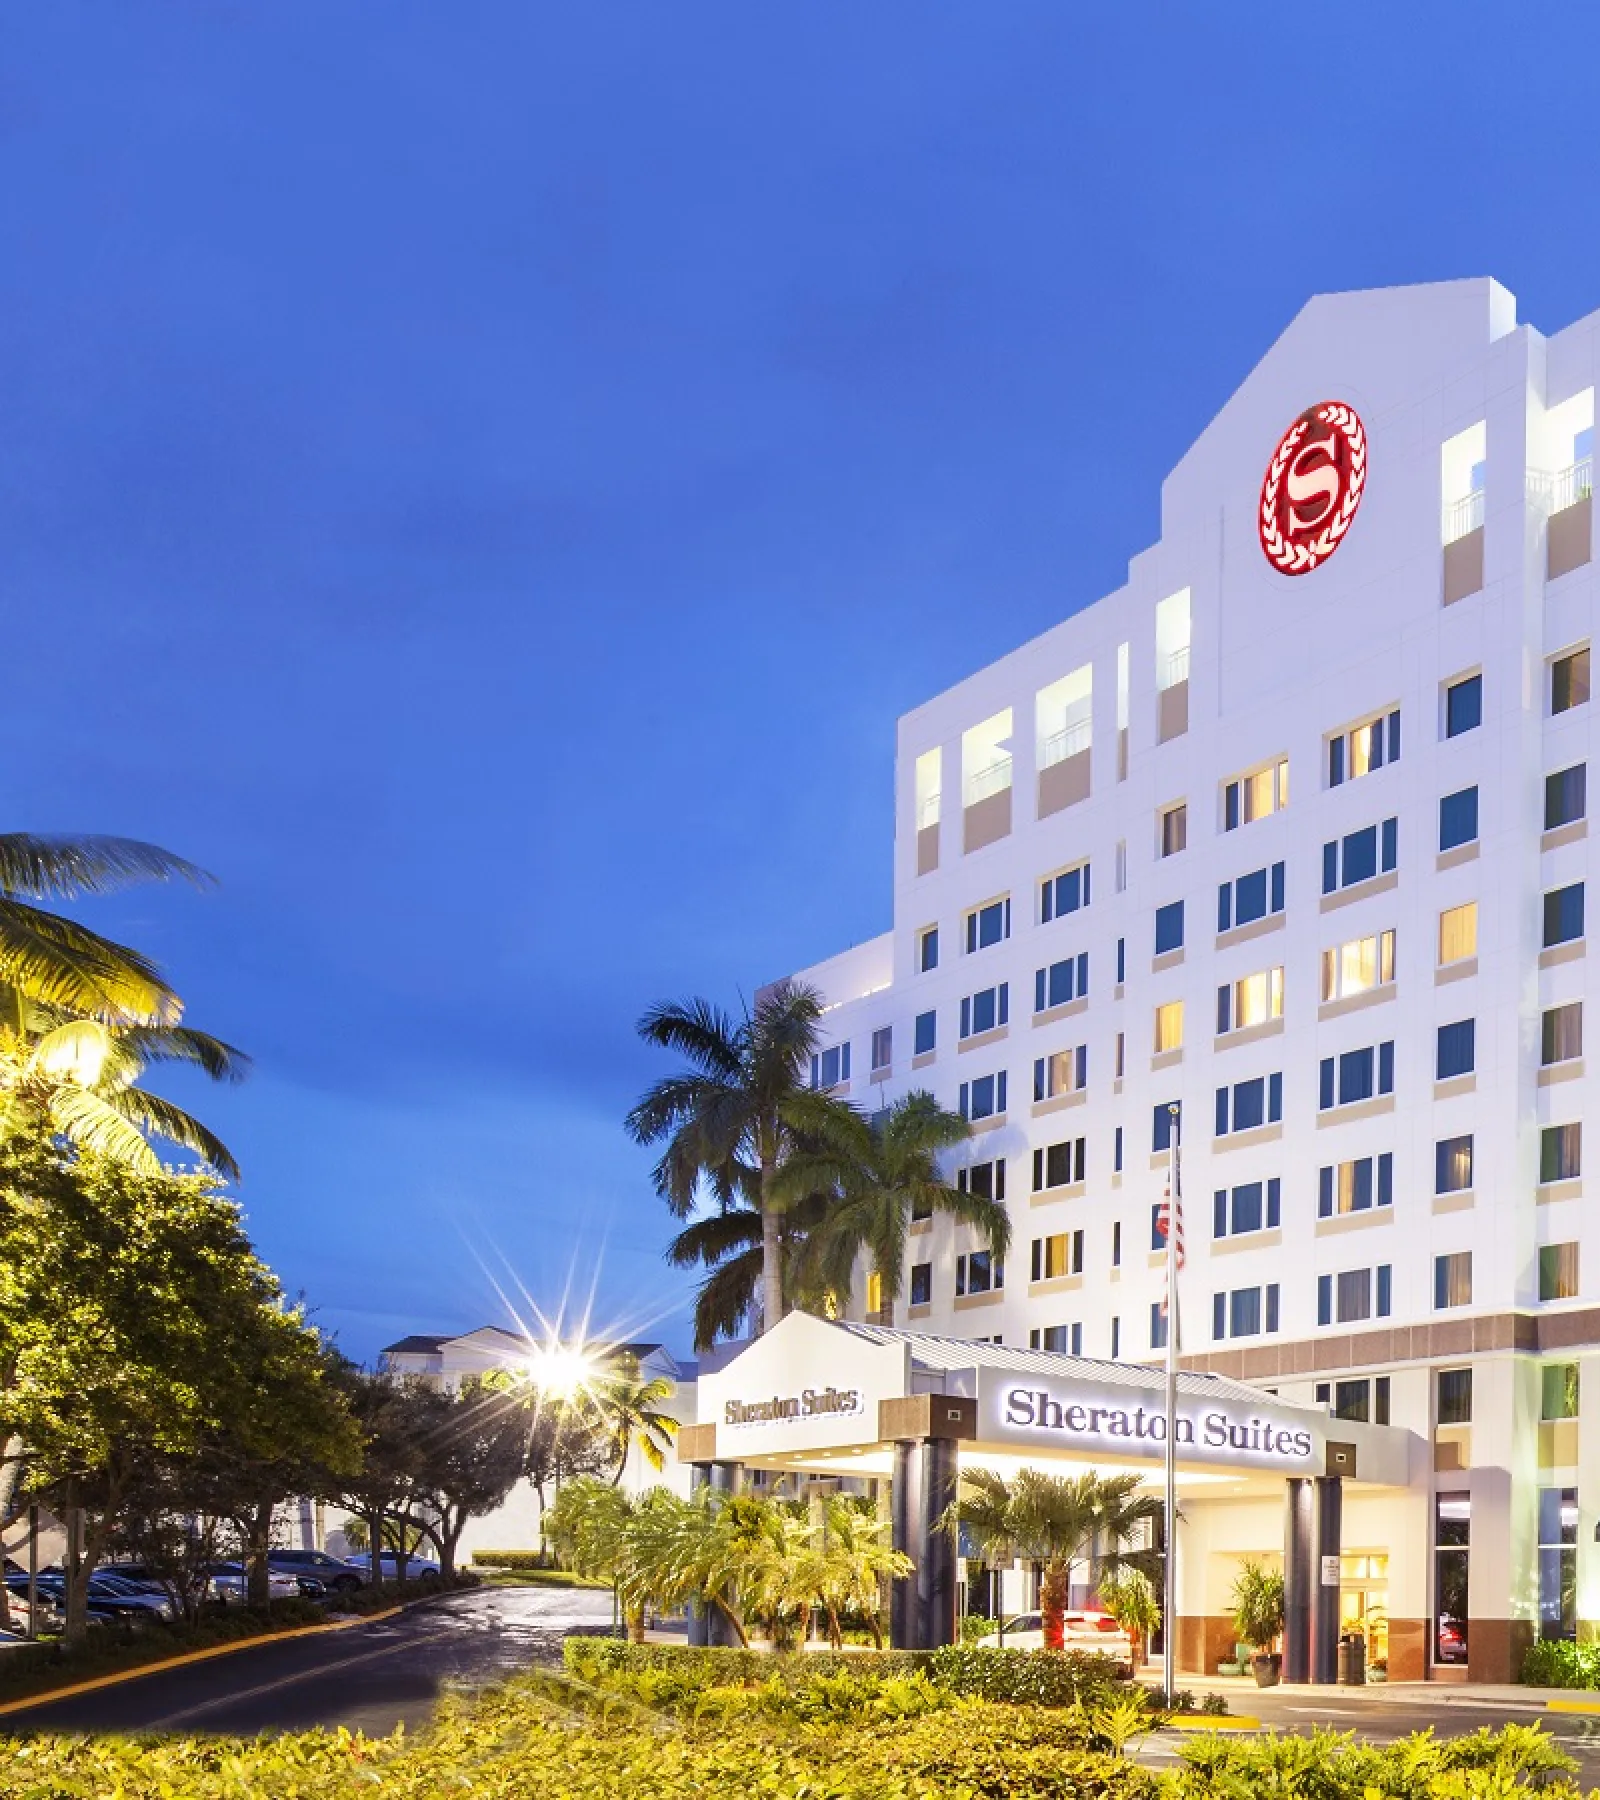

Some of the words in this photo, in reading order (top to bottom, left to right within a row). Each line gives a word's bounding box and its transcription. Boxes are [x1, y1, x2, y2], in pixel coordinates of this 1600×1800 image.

[1286, 433, 1340, 537] S
[725, 1395, 799, 1425] Sheraton
[802, 1386, 859, 1415] Suites
[1005, 1389, 1195, 1443] Sheraton
[1203, 1413, 1311, 1457] Suites
